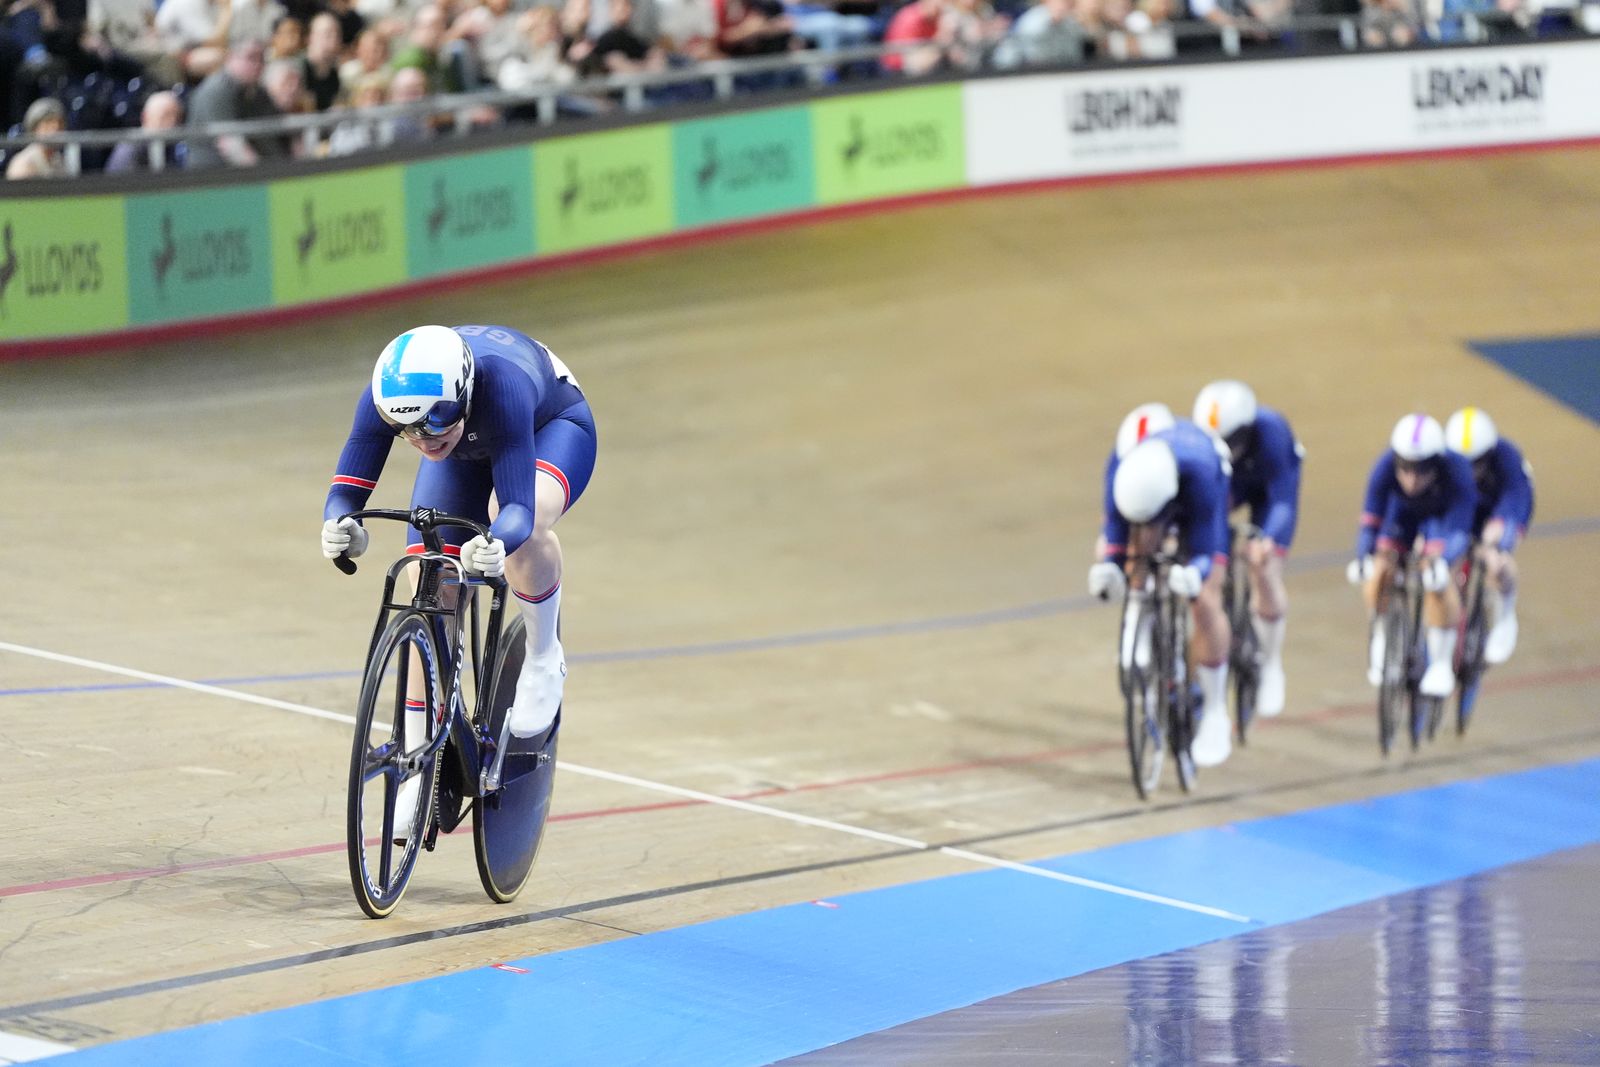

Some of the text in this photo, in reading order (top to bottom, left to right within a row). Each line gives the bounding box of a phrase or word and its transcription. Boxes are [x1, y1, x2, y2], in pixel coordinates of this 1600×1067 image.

[1411, 61, 1545, 109] LEIGH DAY
[24, 241, 103, 296] LLOYDS
[390, 406, 421, 414] LAZER
[446, 629, 465, 732] LOTUS
